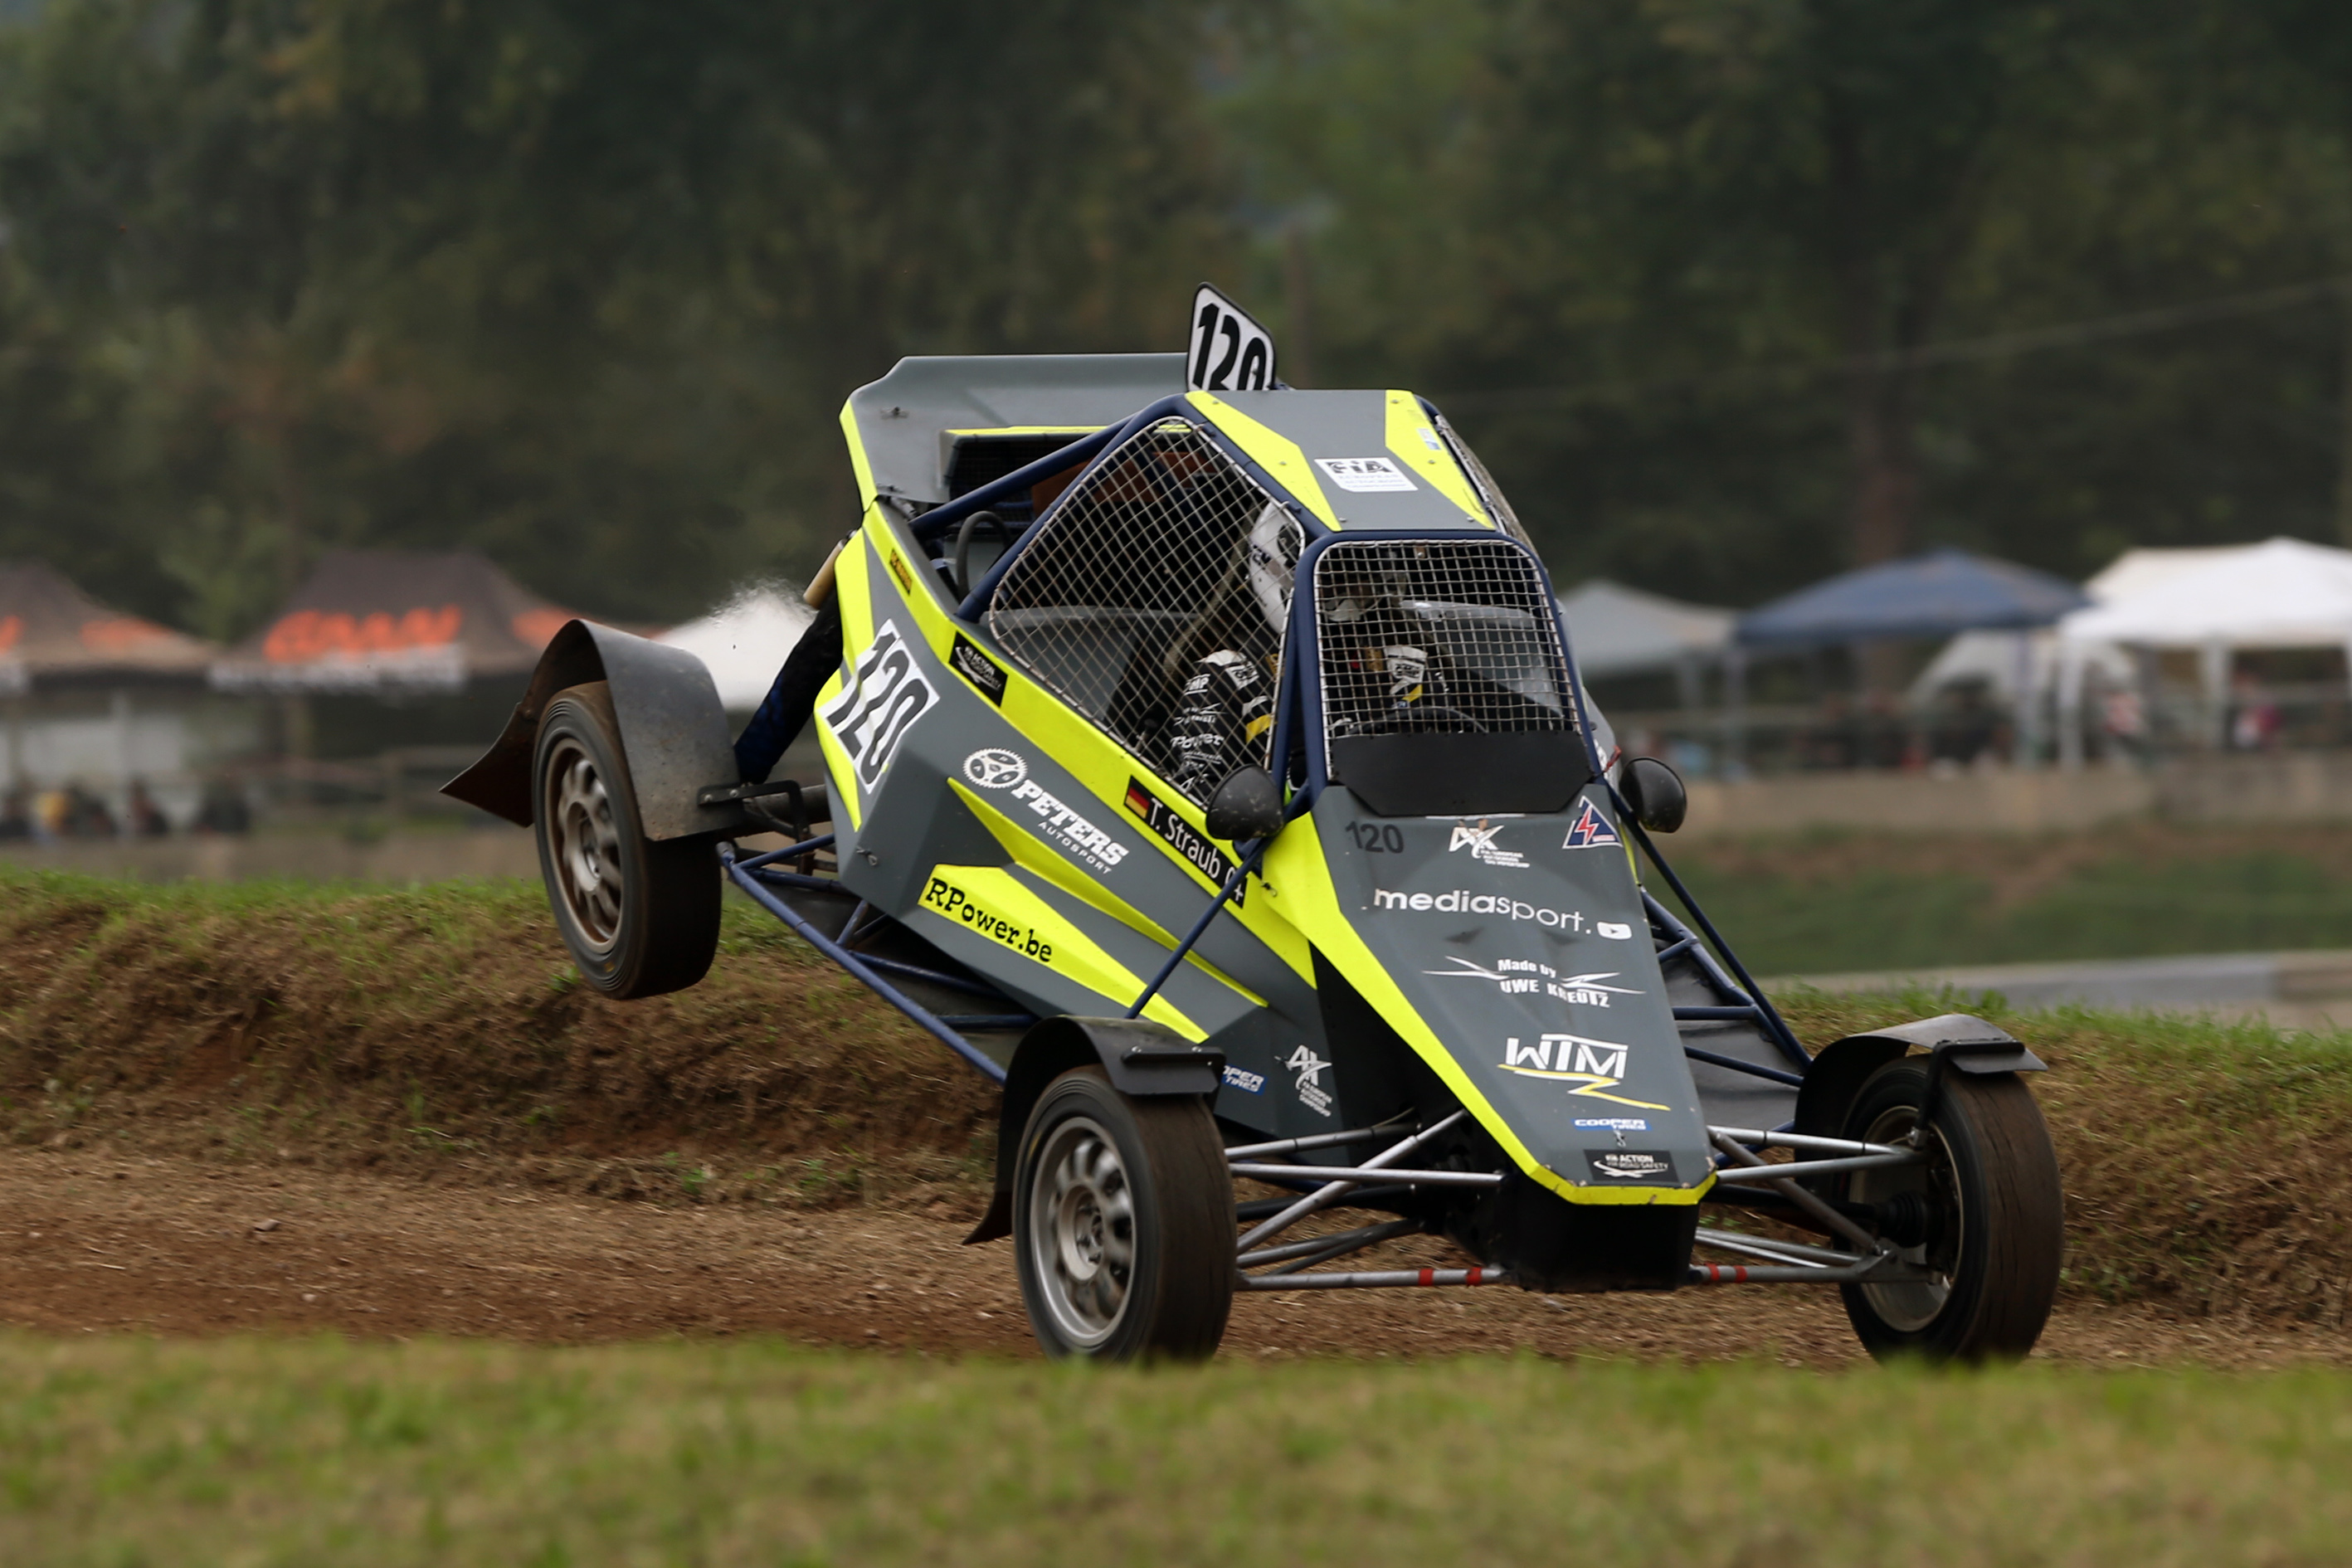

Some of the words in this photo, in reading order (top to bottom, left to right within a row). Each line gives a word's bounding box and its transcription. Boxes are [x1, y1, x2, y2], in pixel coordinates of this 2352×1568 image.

[1192, 303, 1267, 391] 120
[825, 631, 929, 785] 120
[1010, 779, 1129, 866] PETERS
[1150, 797, 1163, 831] T.
[1165, 813, 1221, 879] Straub
[1346, 821, 1405, 854] 120
[1038, 821, 1113, 875] AUTOSPORT
[925, 877, 1053, 962] RPower.be
[1497, 958, 1537, 973] Made
[1540, 961, 1556, 978] by
[1499, 979, 1540, 994] UWE
[1546, 982, 1611, 1009] KREUTZ
[1505, 1033, 1629, 1079] WTM
[1574, 1118, 1646, 1127] COOPER
[1619, 1154, 1654, 1163] ACTION
